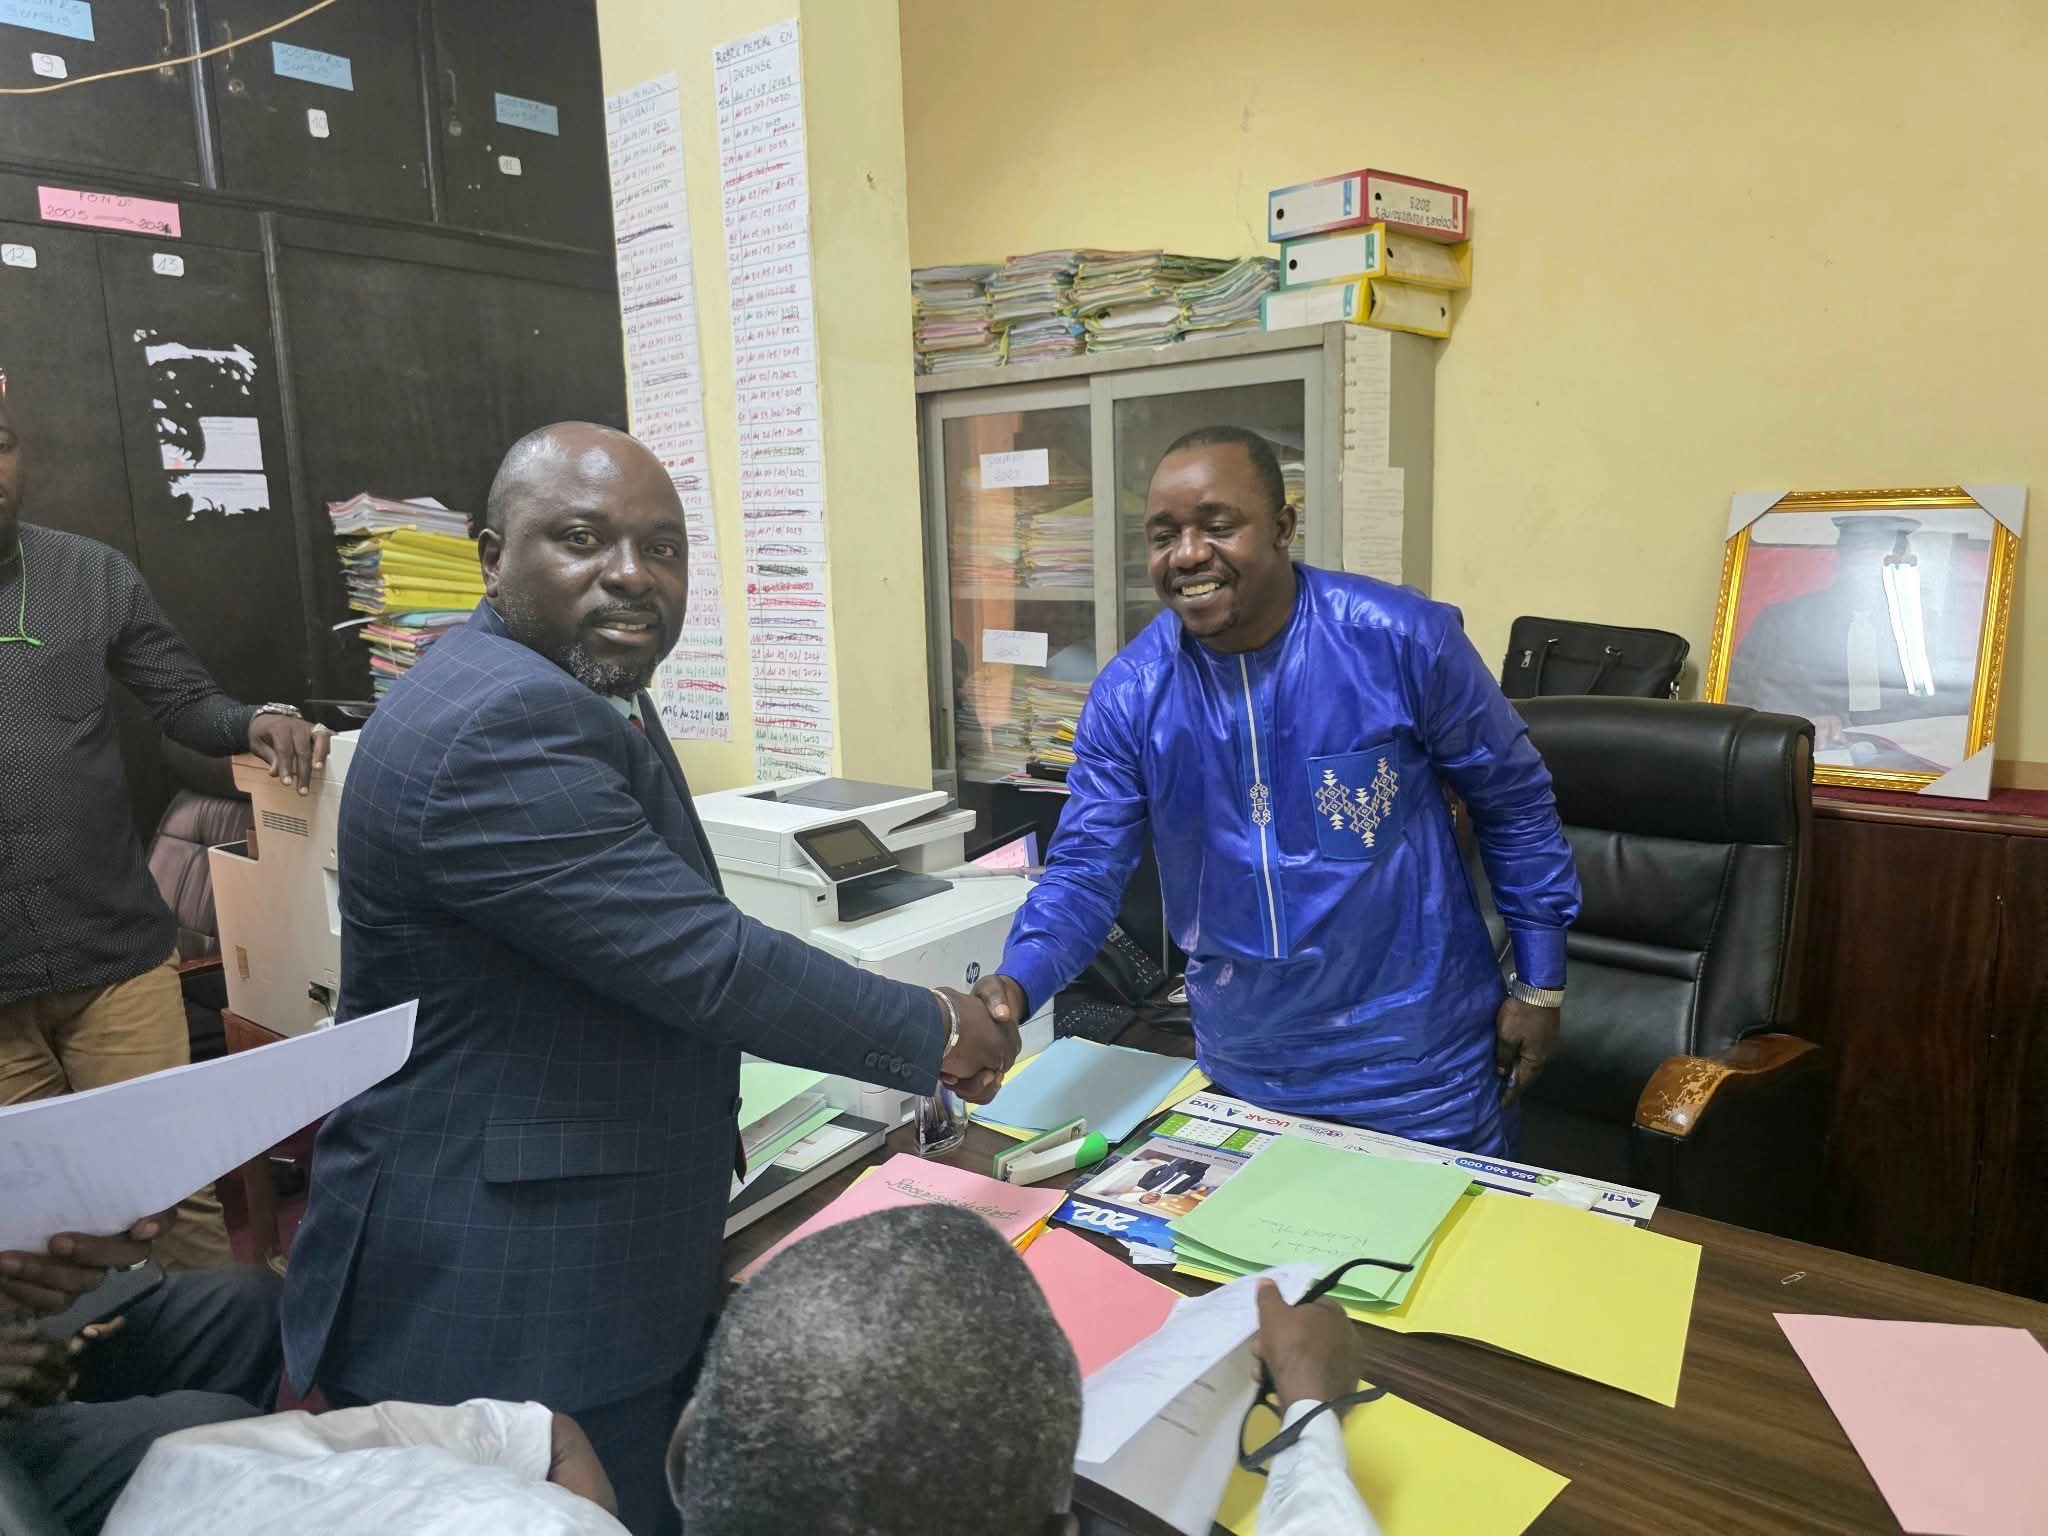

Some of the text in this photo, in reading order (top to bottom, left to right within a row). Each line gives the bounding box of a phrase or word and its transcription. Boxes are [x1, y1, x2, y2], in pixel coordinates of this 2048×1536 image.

[40, 55, 54, 73] 9
[45, 205, 89, 221] 2005
[7, 247, 28, 263] 12
[966, 962, 981, 985] hp
[1244, 1113, 1292, 1129] UGAR
[1458, 1158, 1535, 1181] 656 960 000
